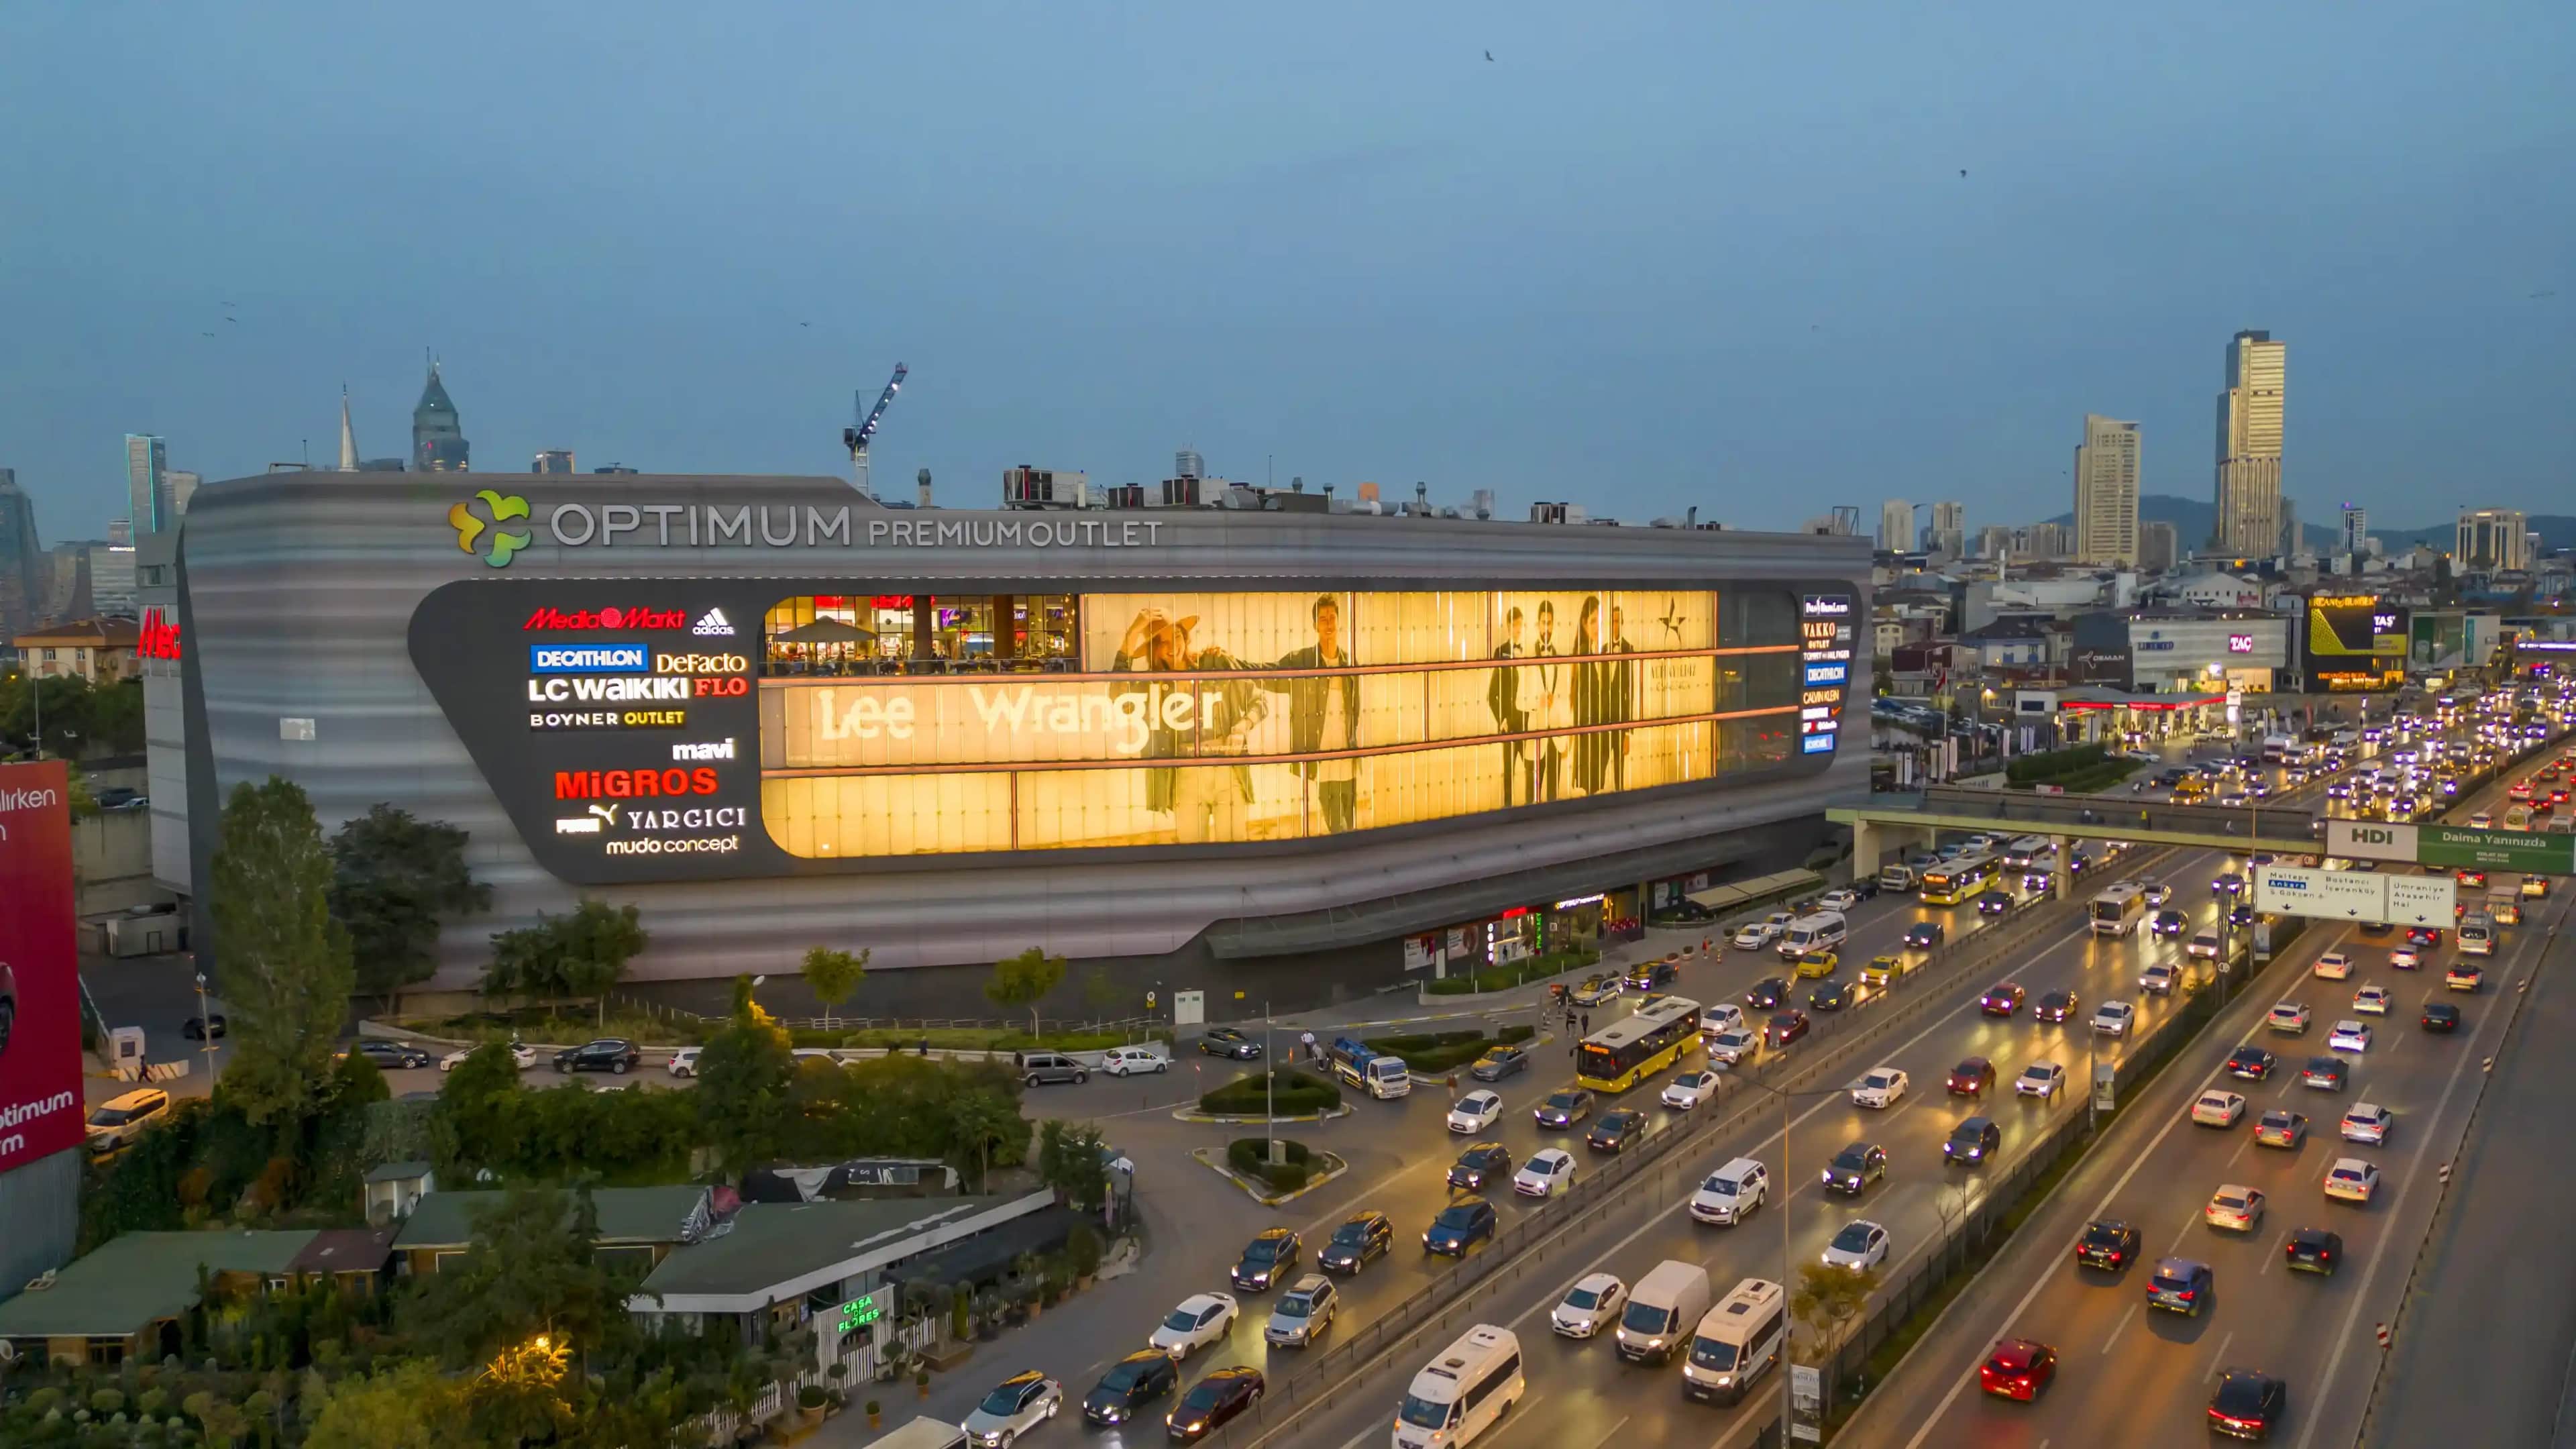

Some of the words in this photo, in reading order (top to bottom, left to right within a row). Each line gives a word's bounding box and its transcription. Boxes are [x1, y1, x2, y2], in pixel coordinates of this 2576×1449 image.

[551, 503, 851, 547] OPTIMUM
[869, 521, 1021, 547] PREMIUM
[1028, 521, 1163, 547] OUTLET
[1803, 622, 1836, 637] VAKKO
[2231, 637, 2251, 651] TAÇ
[538, 650, 642, 667] DECATHLON
[656, 653, 747, 674] DeFacto
[529, 678, 570, 702] LC
[694, 678, 748, 696] FLO
[531, 712, 618, 727] BOYNER
[624, 711, 685, 724] OUTLET
[819, 688, 915, 741] Lee
[969, 683, 1224, 755] Wrangler
[672, 738, 735, 760] mavi
[0, 787, 56, 812] lırken
[627, 808, 746, 830] YARGICI
[606, 838, 661, 855] mudo
[663, 835, 739, 854] concept
[2351, 828, 2393, 845] HDI
[2443, 831, 2481, 844] Daima
[2270, 872, 2310, 881] Maltepe
[2270, 880, 2306, 890] Ankara
[843, 1296, 872, 1314] CASA
[853, 1308, 863, 1317] DE
[839, 1308, 879, 1333] FLORES
